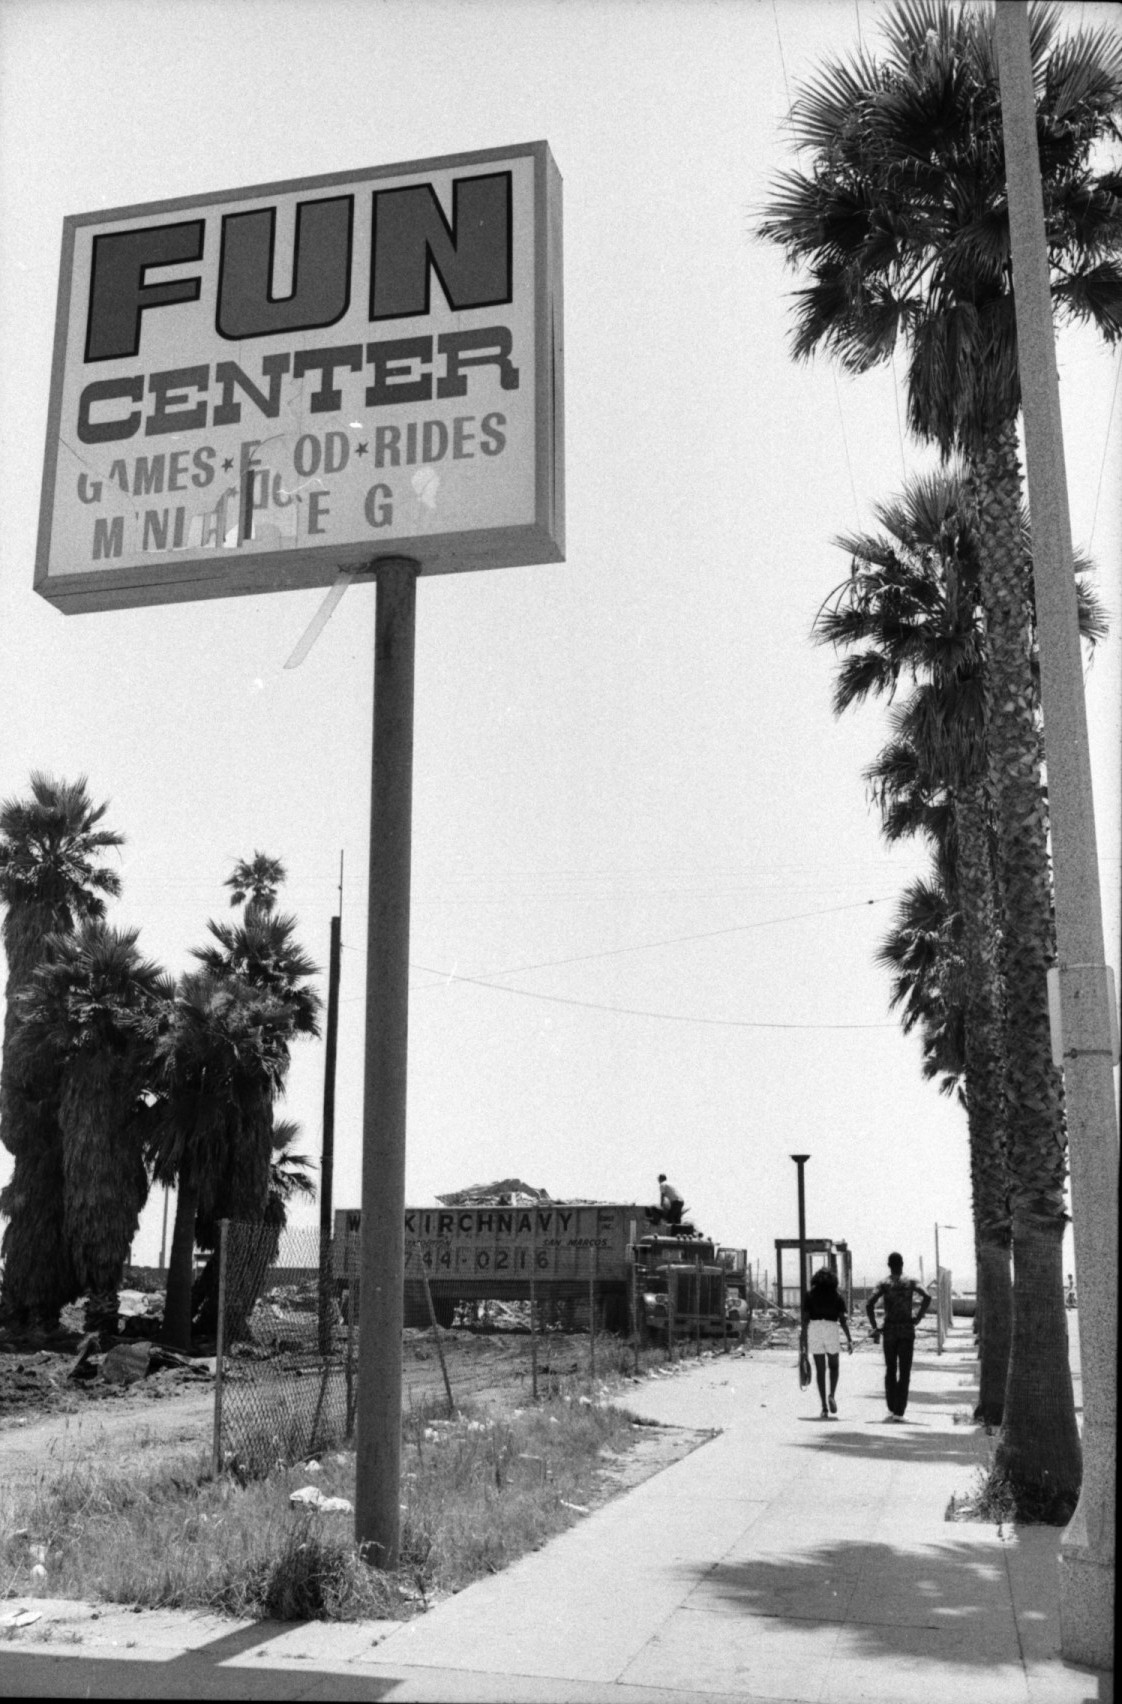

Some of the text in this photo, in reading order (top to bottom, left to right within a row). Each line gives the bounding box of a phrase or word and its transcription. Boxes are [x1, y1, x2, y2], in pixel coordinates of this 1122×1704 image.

[83, 170, 513, 364] FUN
[76, 325, 520, 446] CENTER
[77, 445, 217, 505] GAMES
[374, 411, 508, 469] RIDES
[568, 1238, 608, 1248] MARCOS
